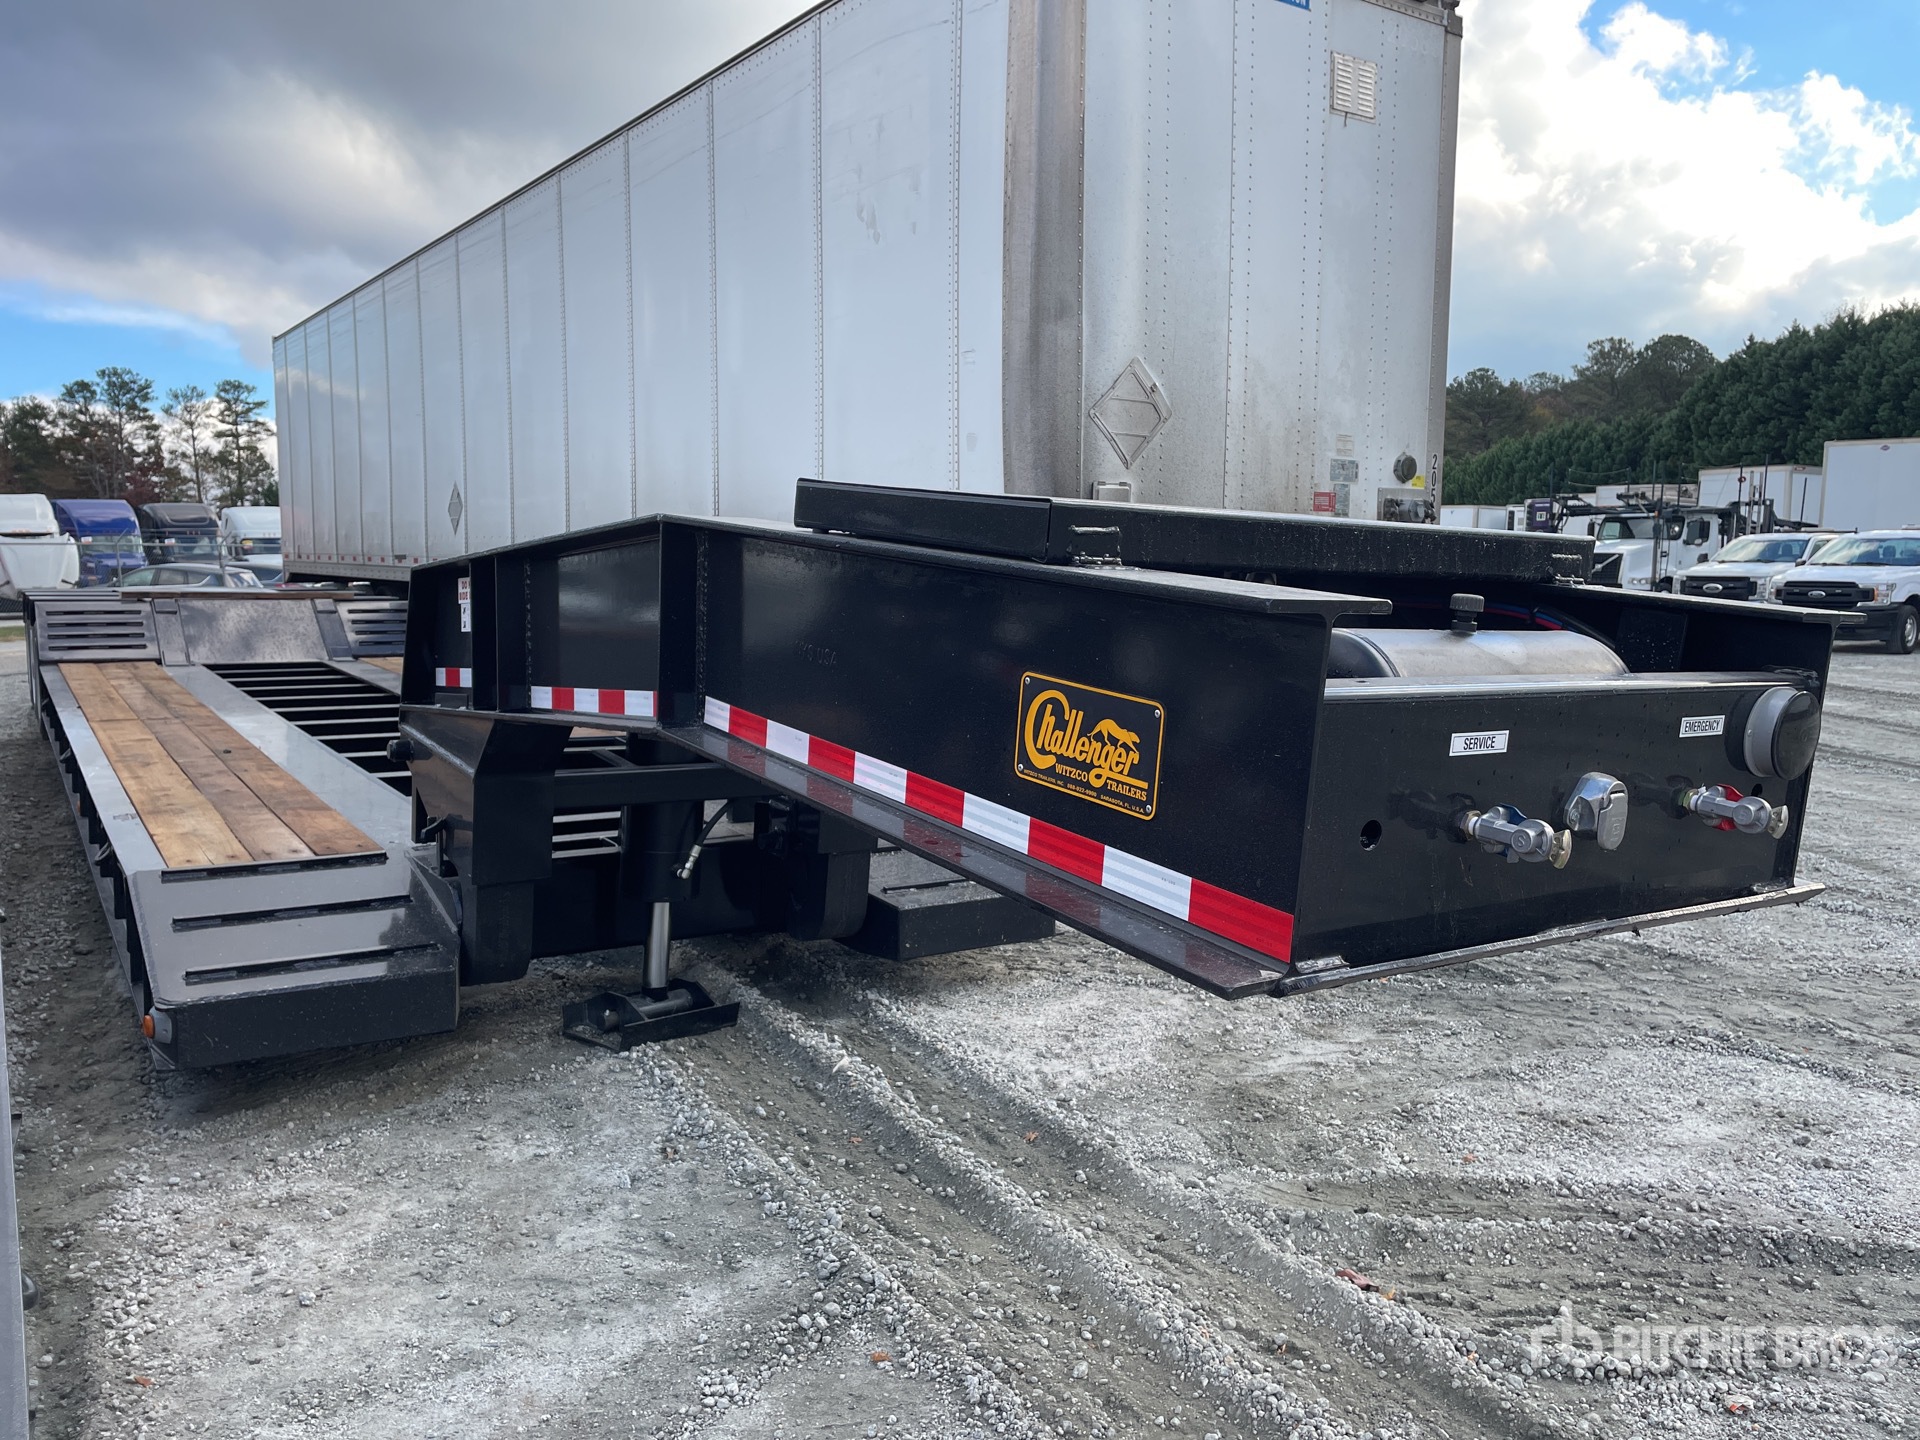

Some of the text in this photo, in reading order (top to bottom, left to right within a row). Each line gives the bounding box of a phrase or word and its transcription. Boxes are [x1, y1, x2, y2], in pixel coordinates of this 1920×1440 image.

[1024, 690, 1143, 788] Challenger
[1685, 719, 1720, 733] EMERGENCY
[1463, 736, 1496, 751] SERVICE
[1055, 763, 1147, 801] WITZCO TRAILERS
